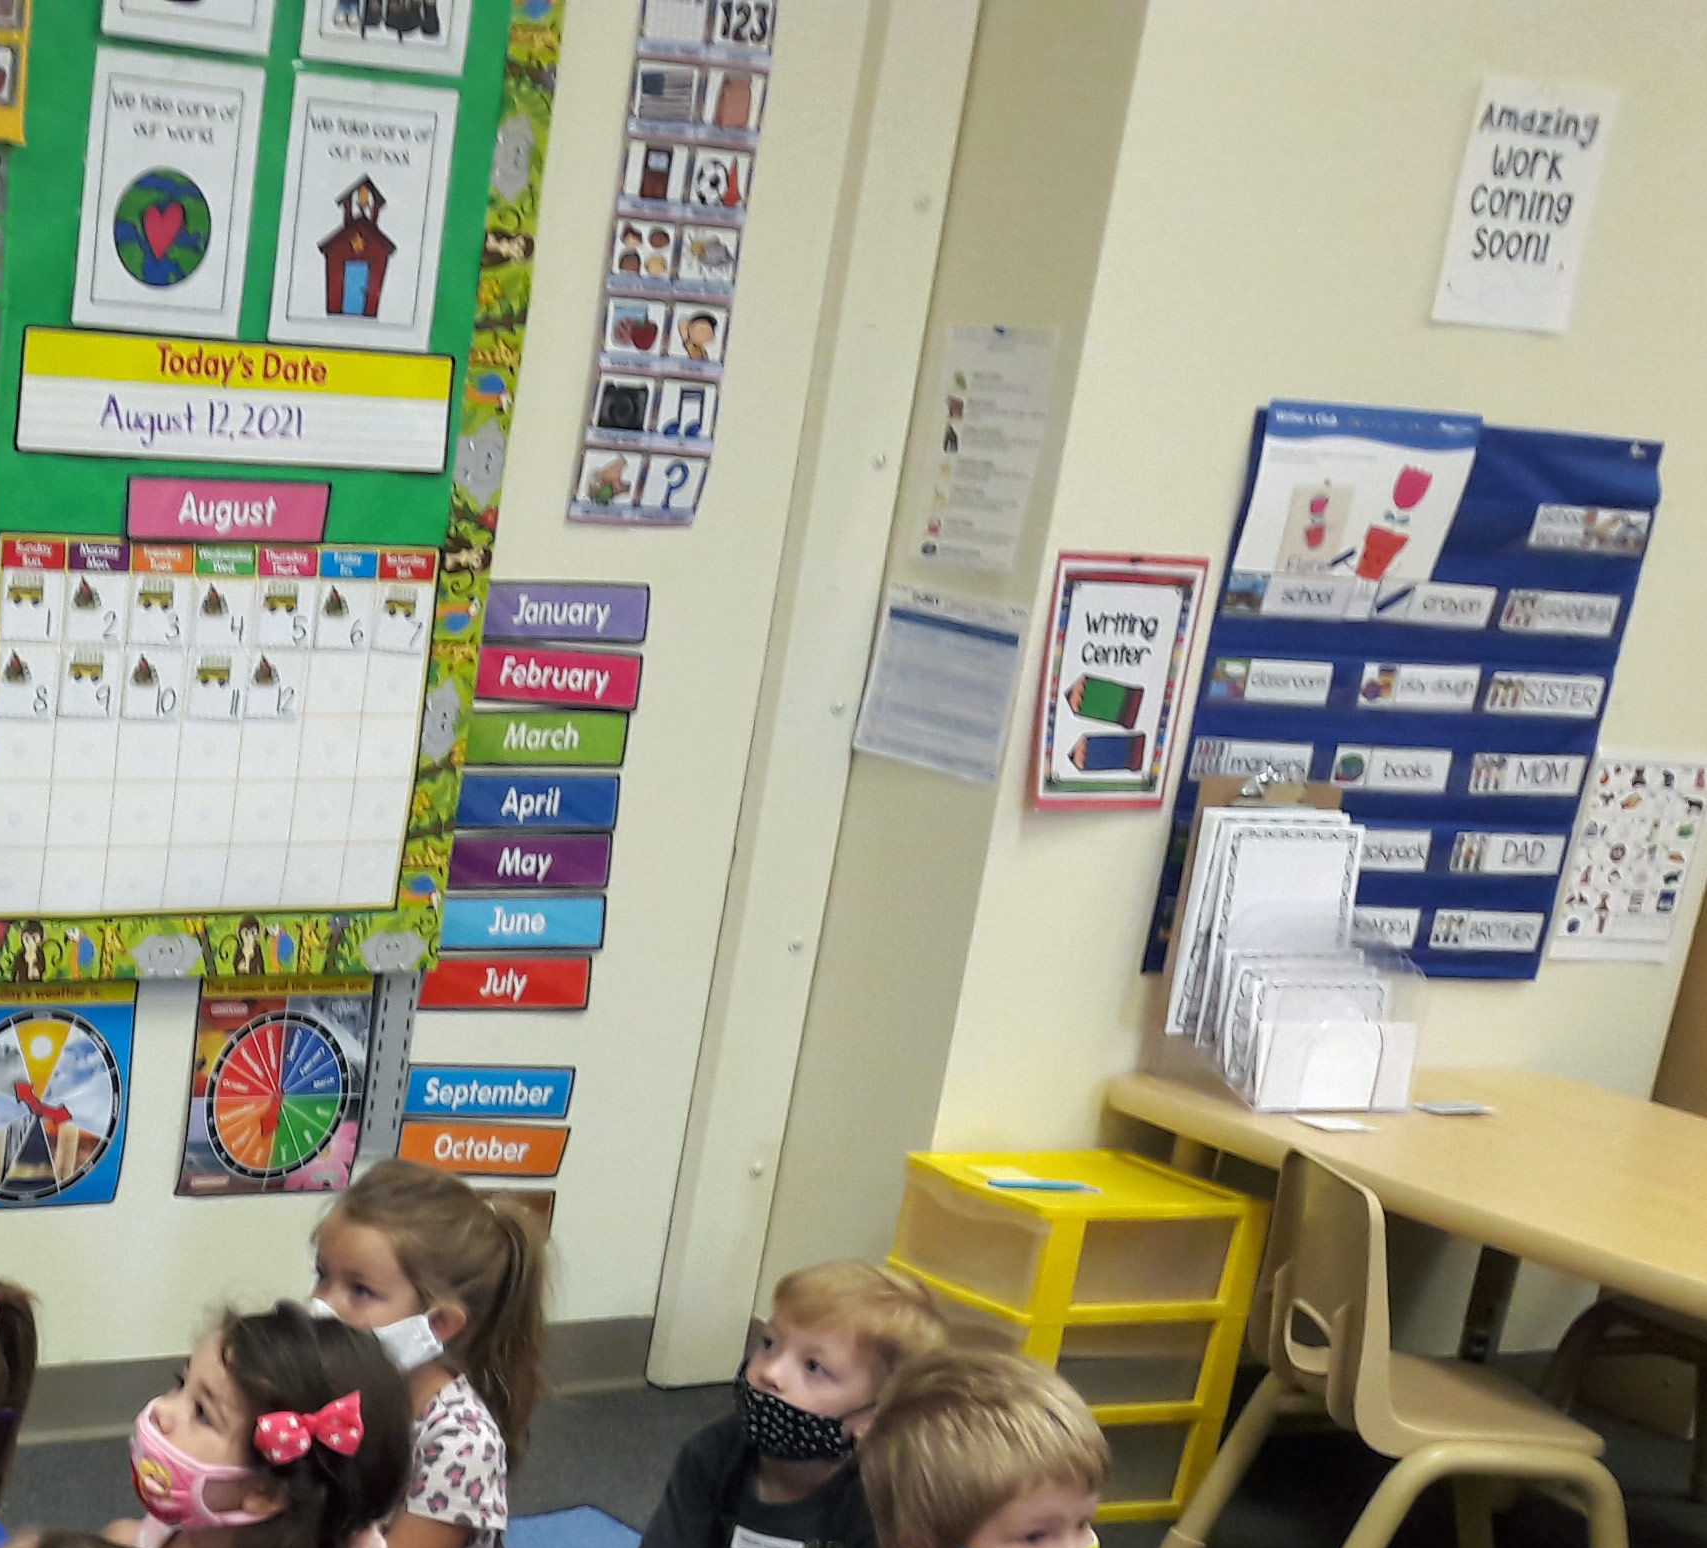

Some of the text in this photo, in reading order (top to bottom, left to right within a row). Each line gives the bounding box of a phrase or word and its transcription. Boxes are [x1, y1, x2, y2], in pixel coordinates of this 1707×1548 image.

[1480, 102, 1600, 149] Amazing
[157, 342, 328, 387] Today's Date
[100, 394, 192, 448] August
[178, 491, 278, 534] August
[79, 542, 120, 560] Monday
[101, 610, 117, 639] 2
[165, 613, 180, 641] 3
[230, 616, 243, 642] 4
[512, 593, 612, 634] January
[1085, 611, 1159, 640] Writing
[292, 615, 307, 646] 5
[350, 617, 364, 647] 6
[404, 618, 423, 647] 7
[1081, 641, 1152, 667] Center
[499, 655, 611, 700] February
[33, 685, 48, 714] 8
[96, 686, 111, 717] 9
[155, 686, 177, 717] 10
[276, 686, 295, 716] 12
[1524, 682, 1597, 708] SISTER
[503, 720, 580, 752] March
[1515, 761, 1569, 785] MOM
[500, 786, 561, 824] April
[497, 846, 553, 884] May
[1502, 839, 1545, 865] DAD
[488, 905, 547, 935] June
[480, 966, 529, 1002] July
[423, 1076, 554, 1112] September
[434, 1132, 530, 1163] October
